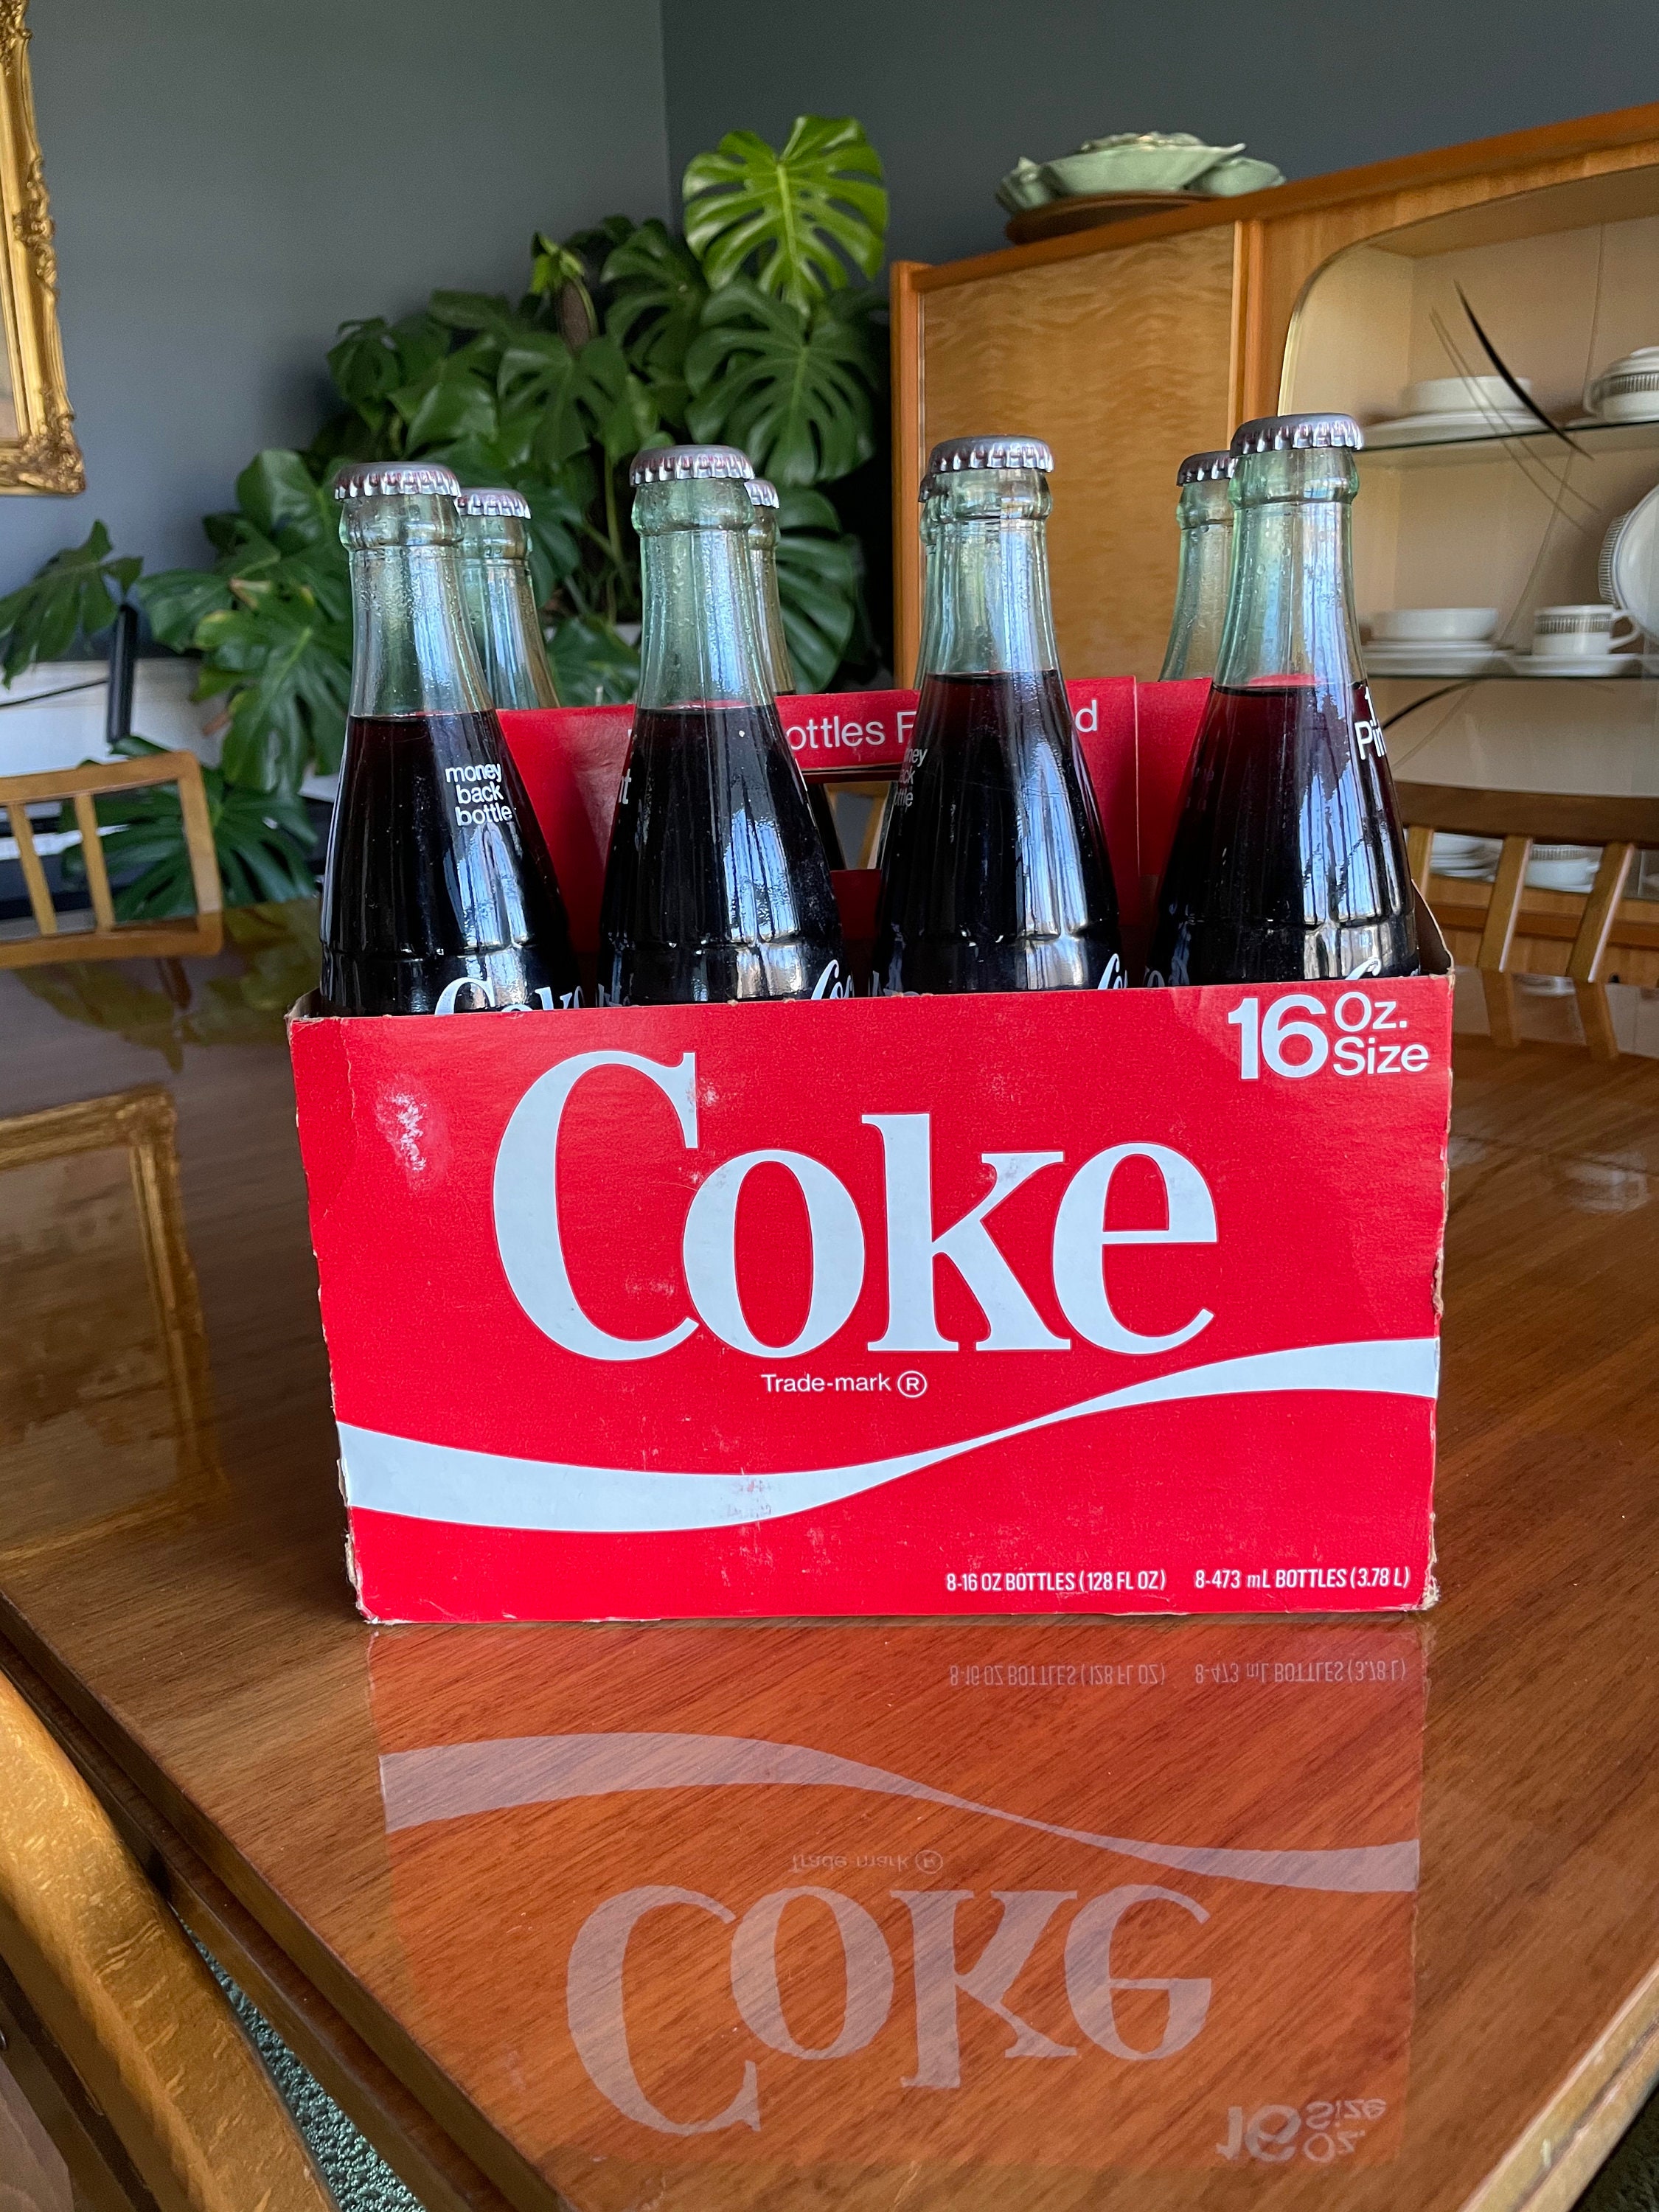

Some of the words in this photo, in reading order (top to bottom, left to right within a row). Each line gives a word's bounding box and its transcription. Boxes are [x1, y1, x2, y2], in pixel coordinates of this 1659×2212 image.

[786, 716, 885, 750] ottles
[445, 763, 502, 783] money
[456, 781, 504, 804] back
[455, 802, 512, 826] bottle
[1334, 991, 1407, 1032] Oz.
[1228, 994, 1329, 1079] 16
[1333, 1036, 1429, 1076] Size
[493, 1050, 1218, 1361] Coke
[761, 1372, 892, 1393] Trade-mark
[947, 1573, 978, 1591] 8-16
[981, 1573, 1001, 1591] OZ
[1006, 1572, 1075, 1591] BOTTLES
[1079, 1570, 1113, 1591] (128
[1117, 1571, 1134, 1590] FL
[1137, 1569, 1166, 1591] OZ)
[1195, 1569, 1240, 1589] 8-473
[1248, 1571, 1270, 1588] mL
[1276, 1568, 1346, 1588] BOTTLES
[1350, 1567, 1389, 1589] (3.78
[1394, 1566, 1411, 1587] L)
